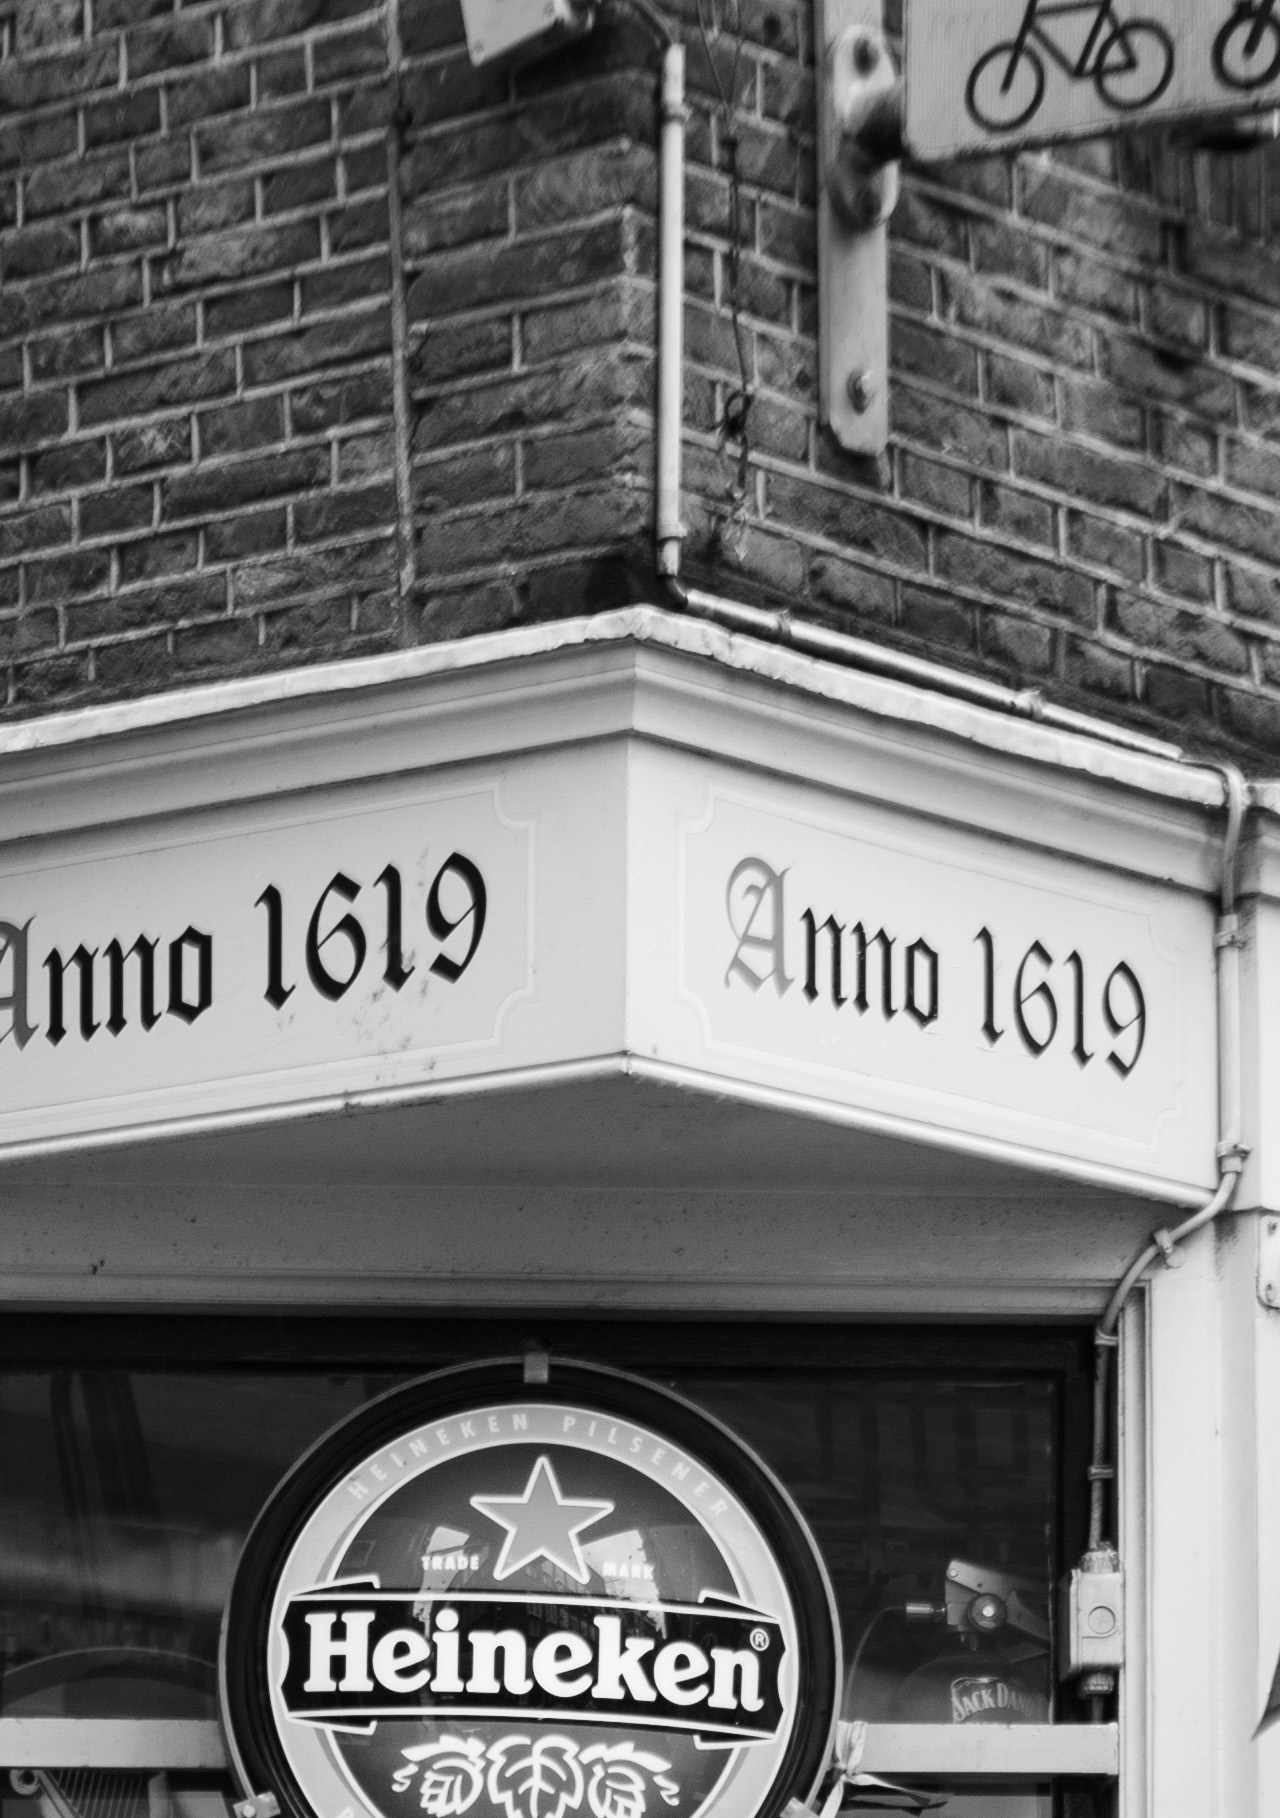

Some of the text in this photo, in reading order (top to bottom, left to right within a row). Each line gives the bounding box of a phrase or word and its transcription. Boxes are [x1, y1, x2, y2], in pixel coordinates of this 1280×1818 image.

[254, 851, 488, 1011] 1619
[724, 856, 1147, 1080] Anno 1619
[346, 1412, 731, 1519] HEINEKEN PILSENER
[421, 1555, 655, 1580] TRADE MARK
[304, 1608, 765, 1712] Heineken
